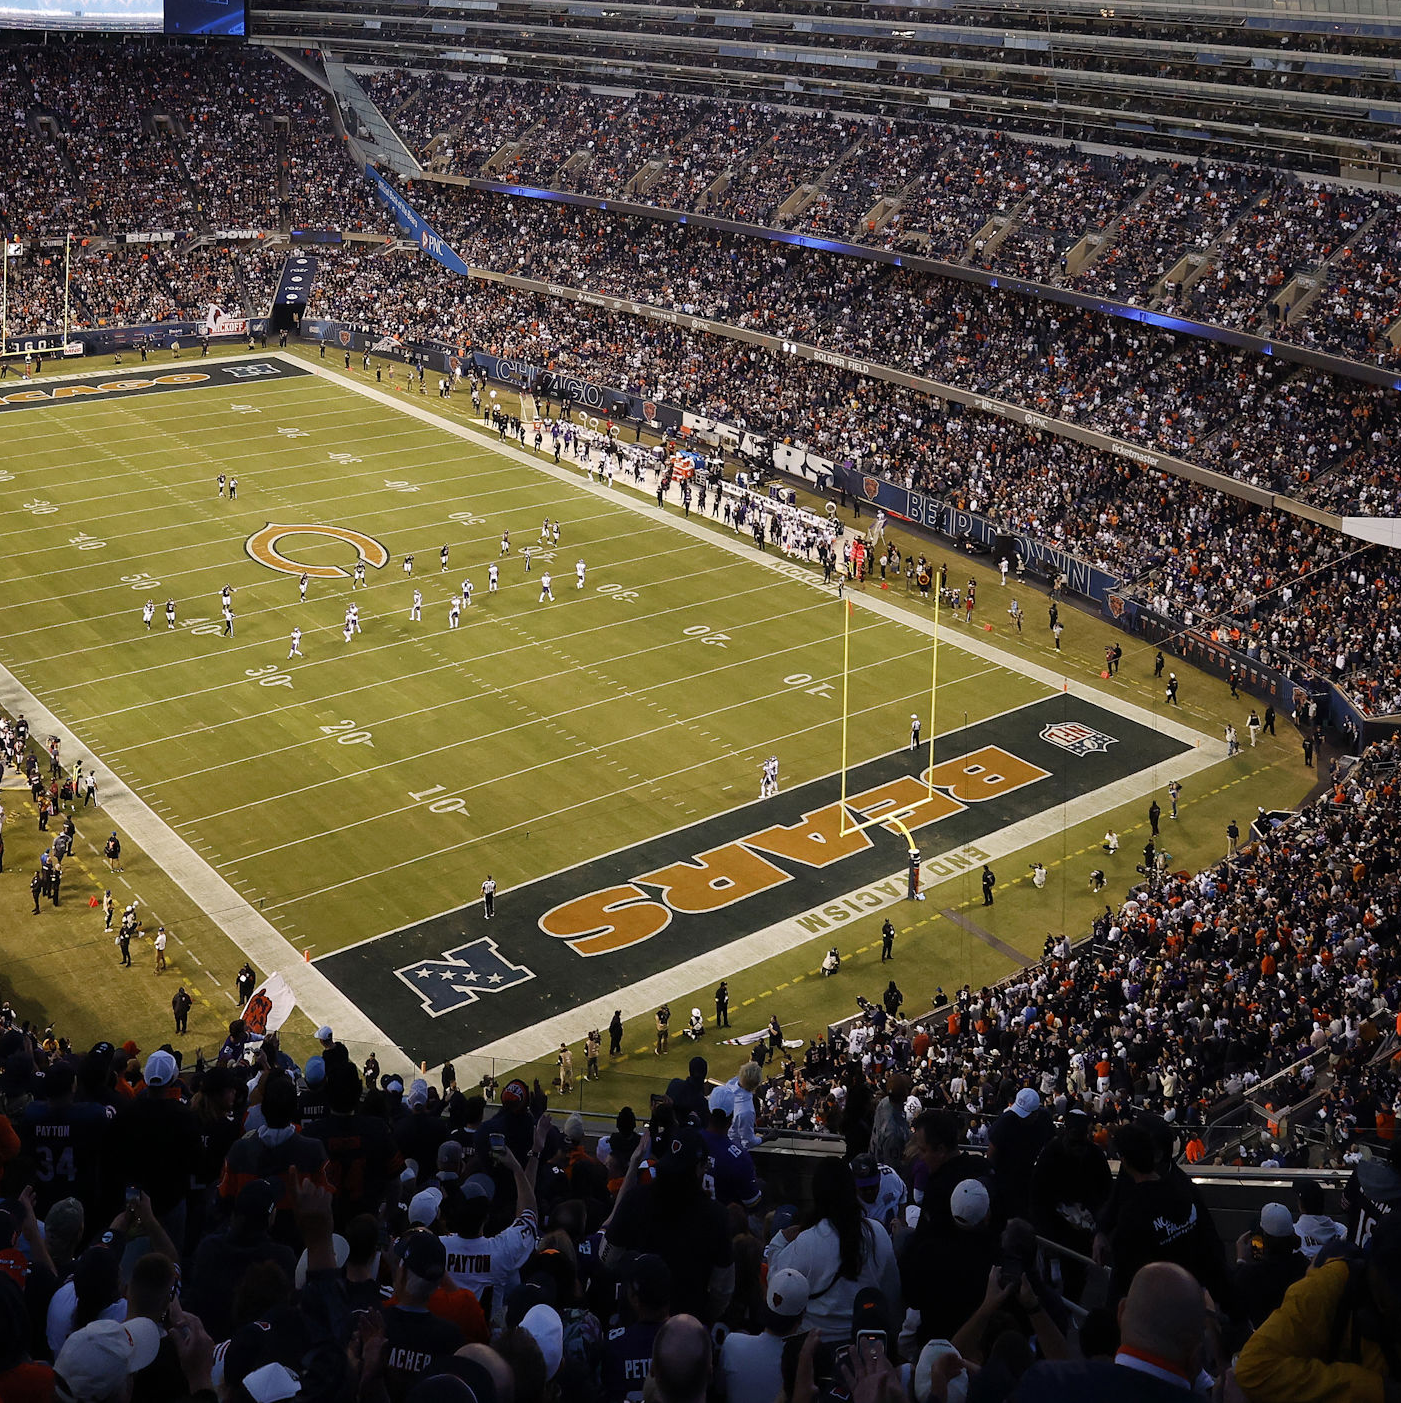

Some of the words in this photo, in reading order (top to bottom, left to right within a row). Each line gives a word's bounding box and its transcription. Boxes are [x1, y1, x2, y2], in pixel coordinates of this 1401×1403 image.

[126, 232, 175, 243] BEAR
[429, 235, 444, 256] PNC
[650, 310, 670, 320] UNITED
[814, 352, 845, 368] SOLDIER
[848, 360, 869, 374] FIELD
[1033, 418, 1048, 429] PNC
[1112, 443, 1159, 466] ticketmaster
[23, 499, 58, 514] 30
[69, 532, 106, 550] 40
[120, 573, 161, 590] 50
[178, 617, 222, 635] 40
[245, 664, 292, 685] 30
[783, 673, 834, 696] 10
[319, 719, 371, 745] 20
[1046, 725, 1094, 743] NFL
[408, 784, 465, 813] 10
[537, 745, 1052, 958] BEARS
[926, 846, 990, 877] END
[36, 1125, 71, 1138] PAYTON
[36, 1145, 78, 1182] 34
[448, 1254, 491, 1274] PAYTON
